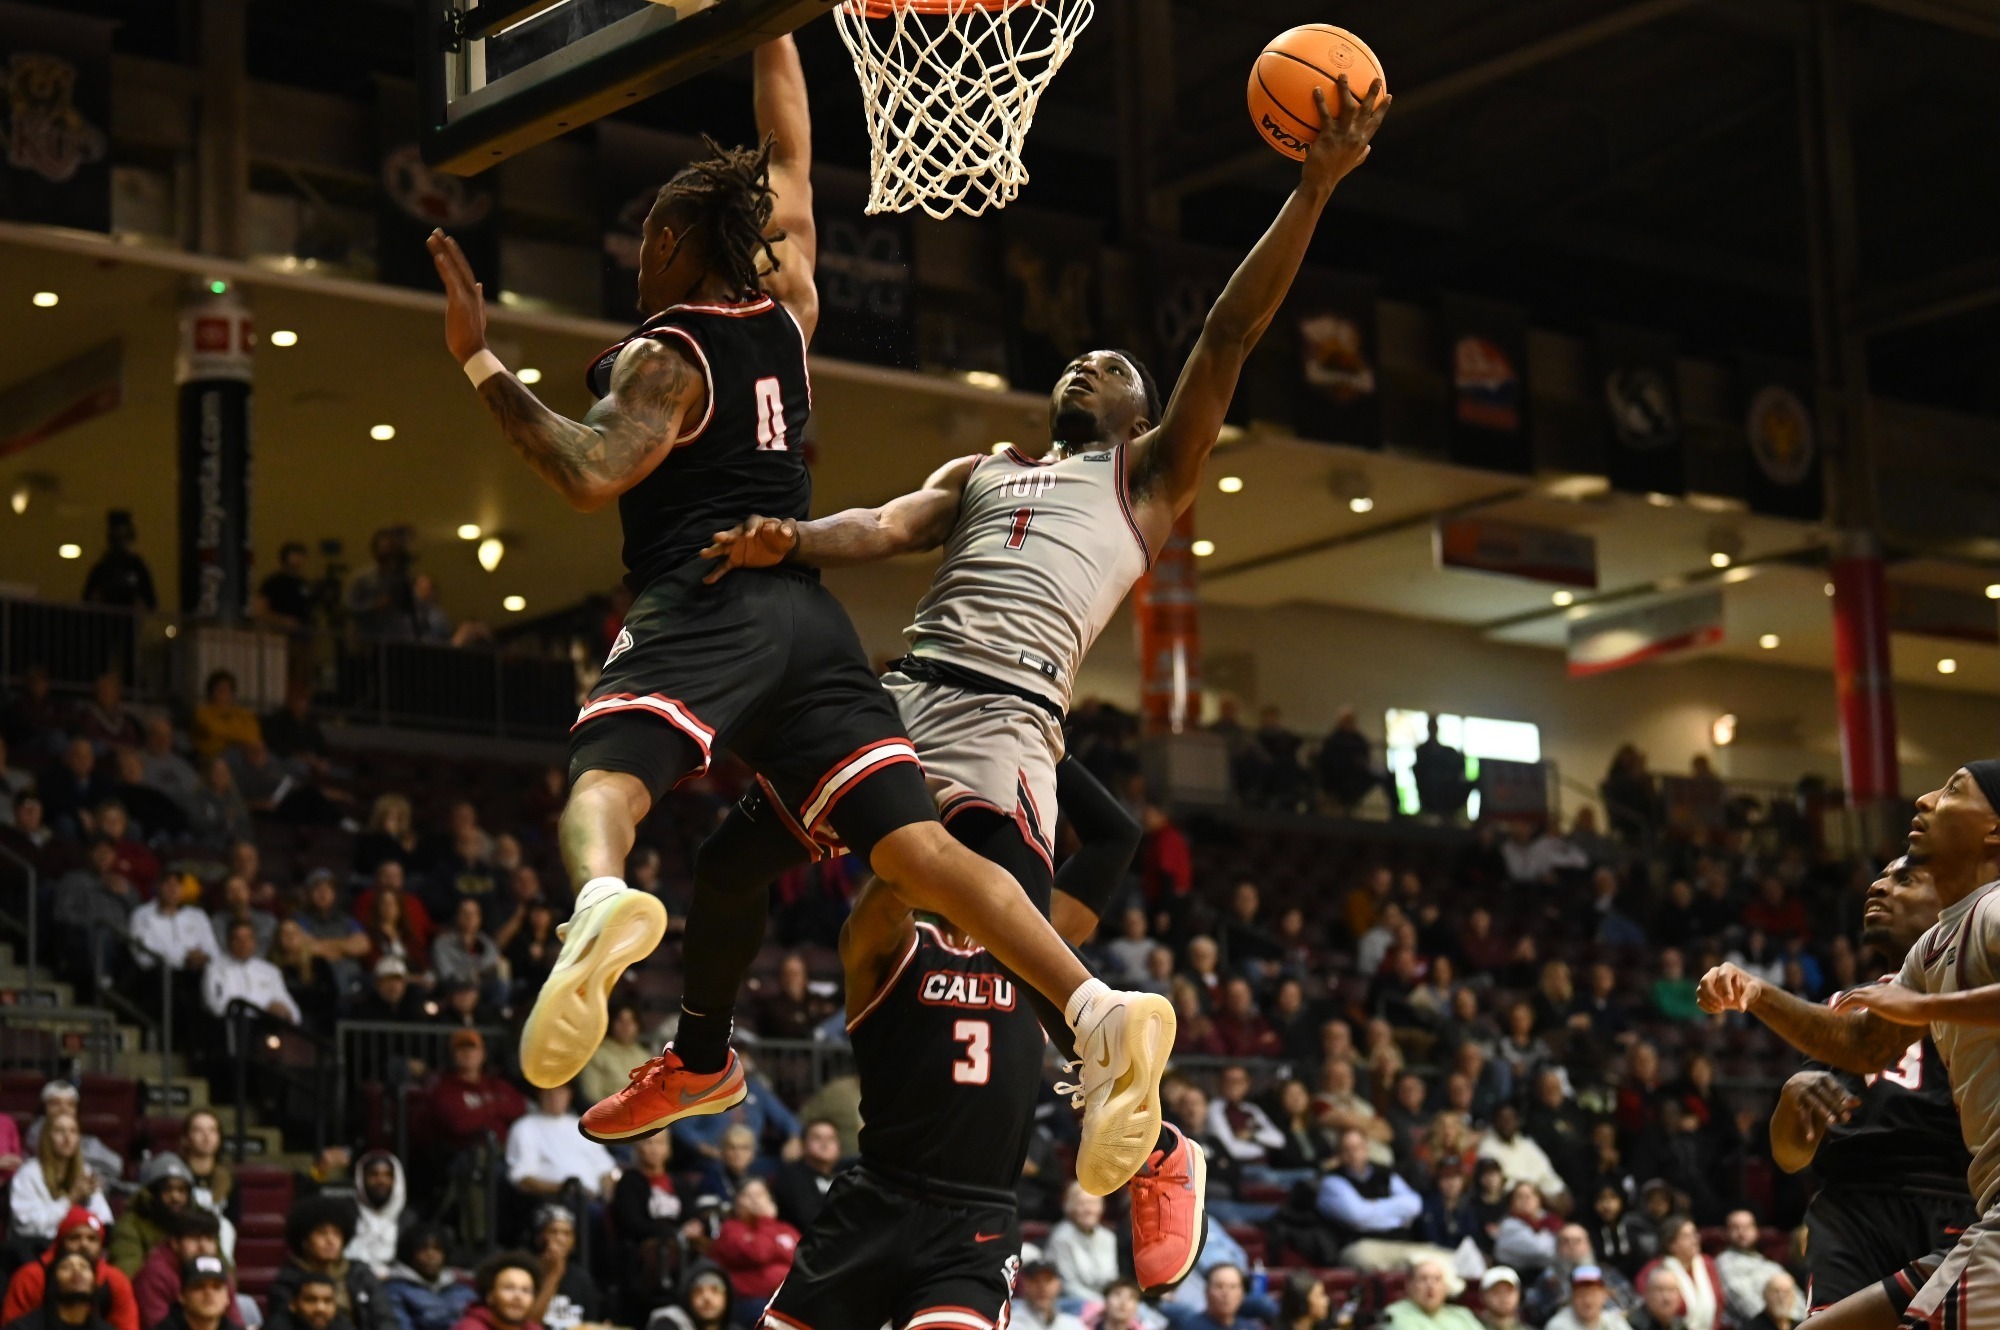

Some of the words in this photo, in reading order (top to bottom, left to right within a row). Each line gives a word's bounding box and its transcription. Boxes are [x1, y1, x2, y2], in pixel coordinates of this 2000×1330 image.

[754, 376, 789, 451] 0
[1004, 508, 1034, 551] 1
[921, 972, 988, 1005] CAL
[993, 976, 1013, 1008] U
[953, 1019, 991, 1085] 3
